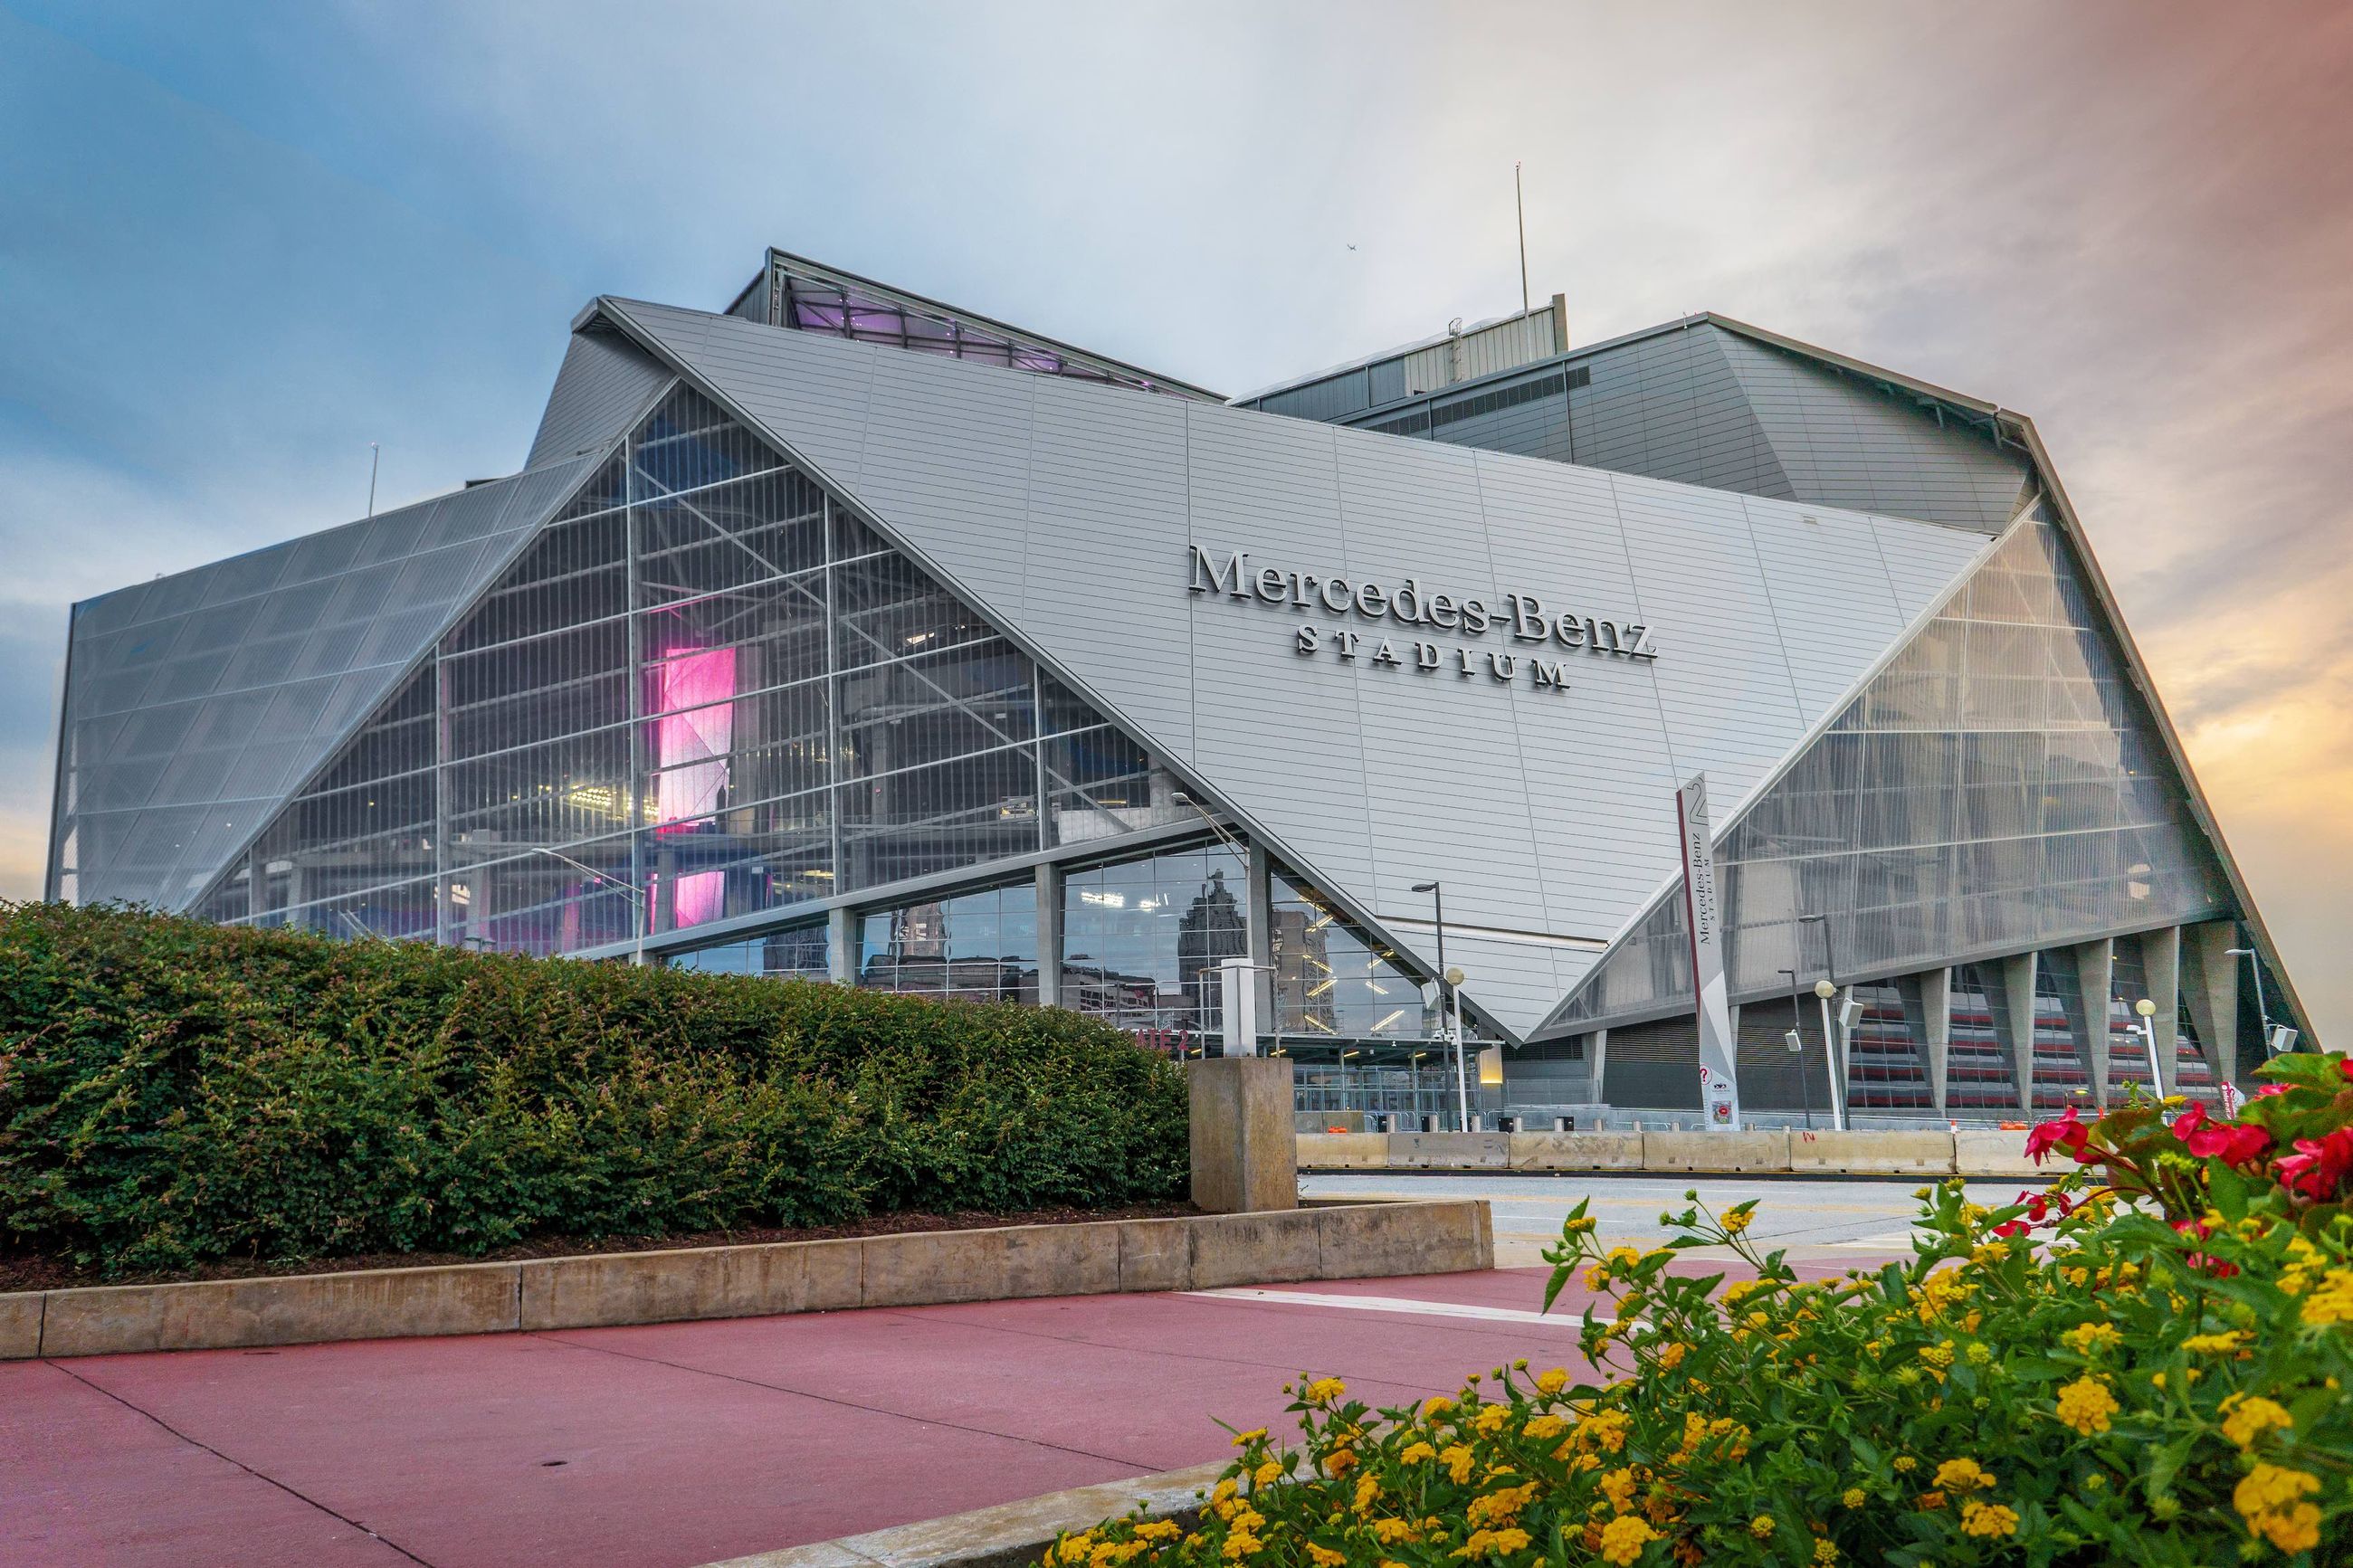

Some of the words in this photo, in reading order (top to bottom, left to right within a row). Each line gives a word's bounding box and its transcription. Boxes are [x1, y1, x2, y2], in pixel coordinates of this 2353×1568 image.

[1189, 544, 1659, 660] Mercedes-Benz
[1297, 624, 1571, 689] STADIUM
[1693, 832, 1710, 946] Mercedes-Benz
[1705, 859, 1716, 922] STADIUM
[1134, 1028, 1172, 1050] ATE
[1177, 1029, 1188, 1050] 2
